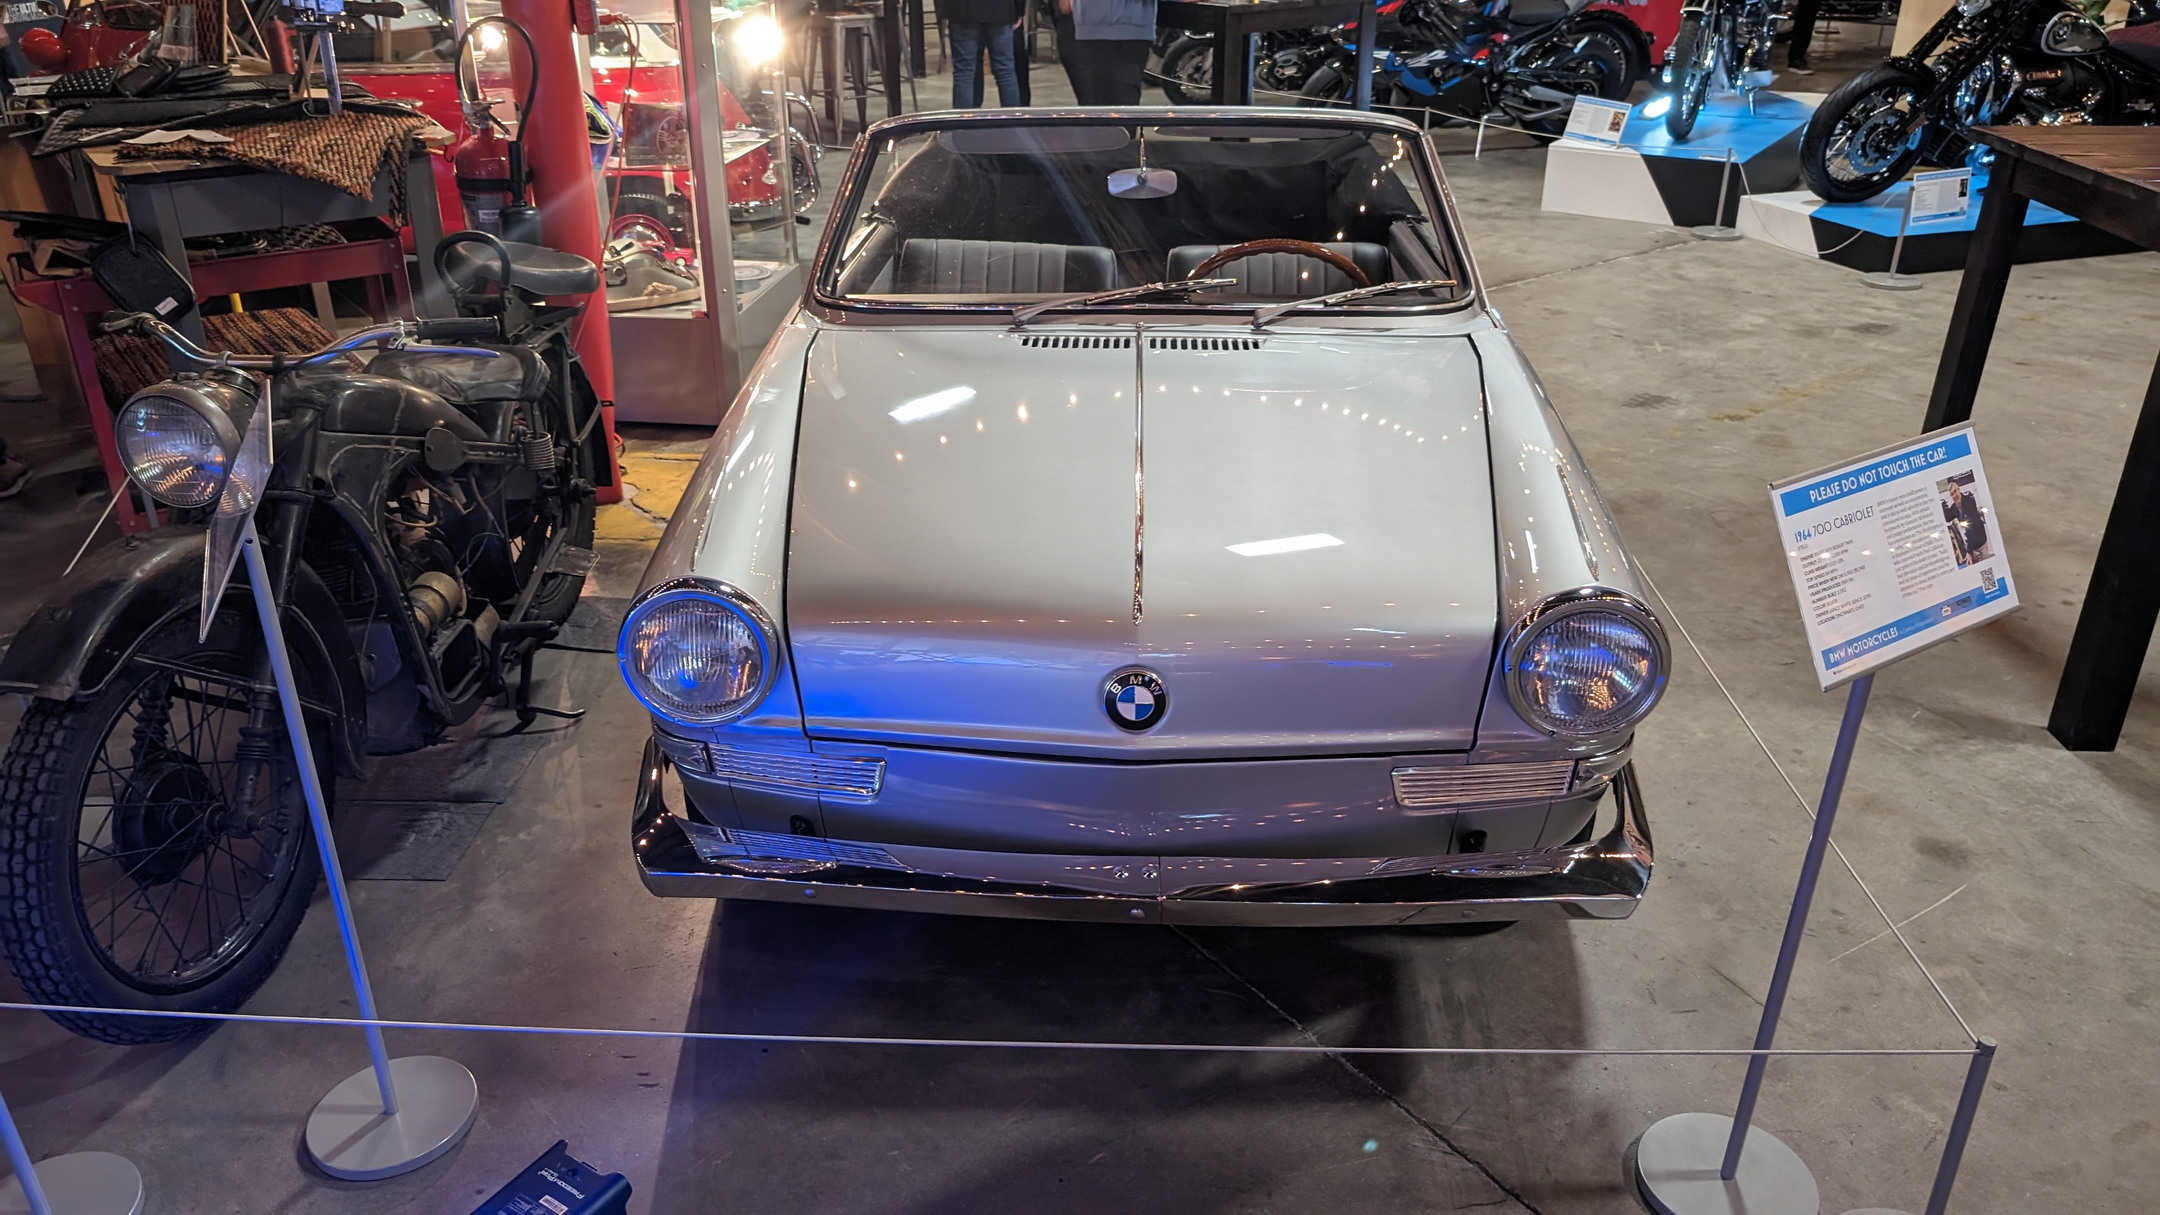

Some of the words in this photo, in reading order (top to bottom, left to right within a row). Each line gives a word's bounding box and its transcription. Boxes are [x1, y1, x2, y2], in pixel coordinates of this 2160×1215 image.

[1809, 482, 1841, 503] PLEASE
[1841, 477, 1858, 492] DO
[1859, 469, 1878, 488] NOT
[1879, 459, 1909, 479] TOUCH
[1909, 453, 1927, 469] THE
[1927, 446, 1948, 463] CAR!
[1794, 530, 1812, 543] 1964
[1812, 521, 1832, 536] 700
[1833, 505, 1875, 530] CABRIOLET
[1829, 648, 1846, 663] BMW
[1847, 626, 1899, 657] MOTORCYCLES
[1110, 675, 1163, 696] BMW
